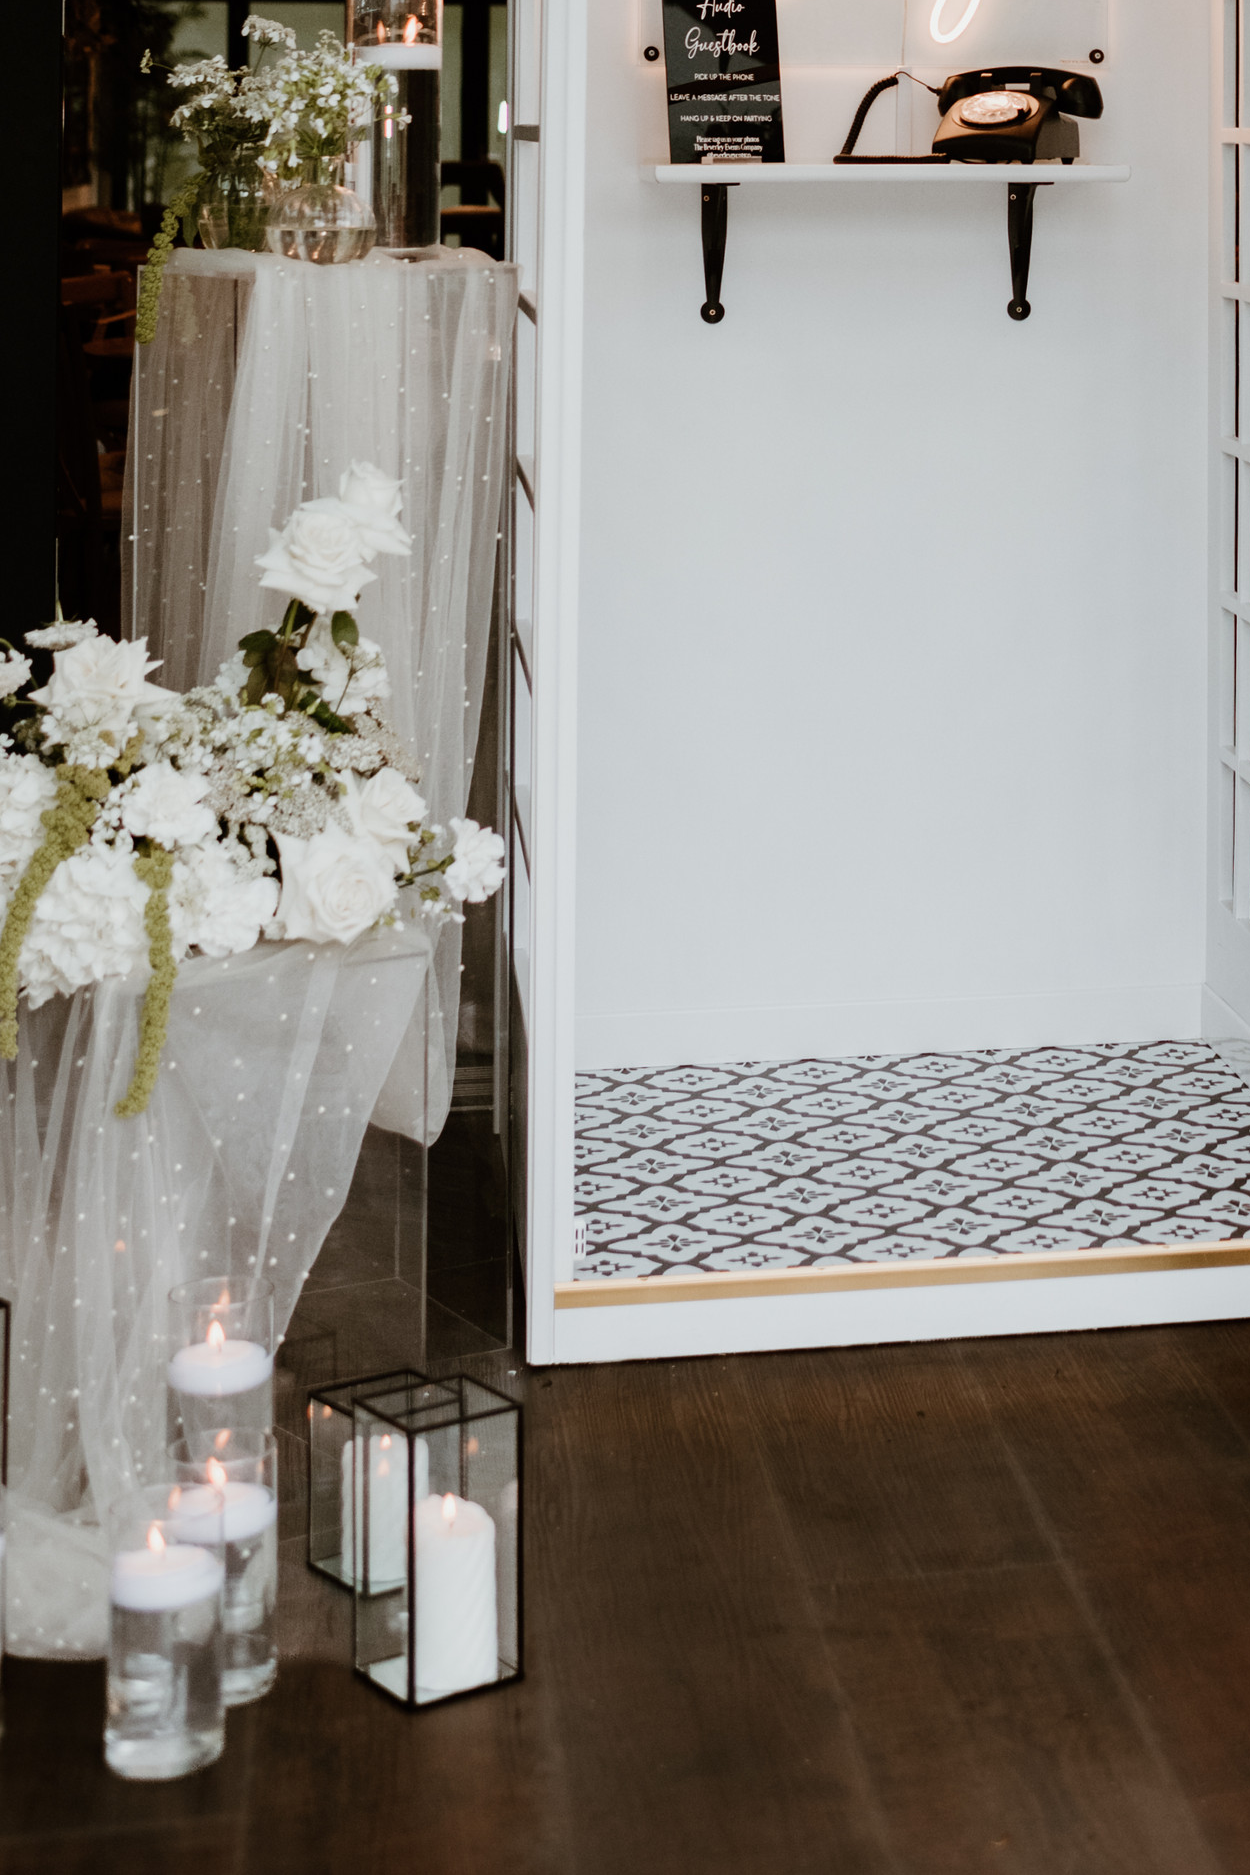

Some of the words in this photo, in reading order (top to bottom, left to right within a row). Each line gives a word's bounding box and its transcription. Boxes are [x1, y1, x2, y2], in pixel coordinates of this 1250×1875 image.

[685, 26, 760, 60] Guestbook
[732, 73, 754, 81] PHONE
[670, 93, 690, 101] LEAVE
[748, 94, 761, 102] THE
[762, 94, 780, 102] TONE
